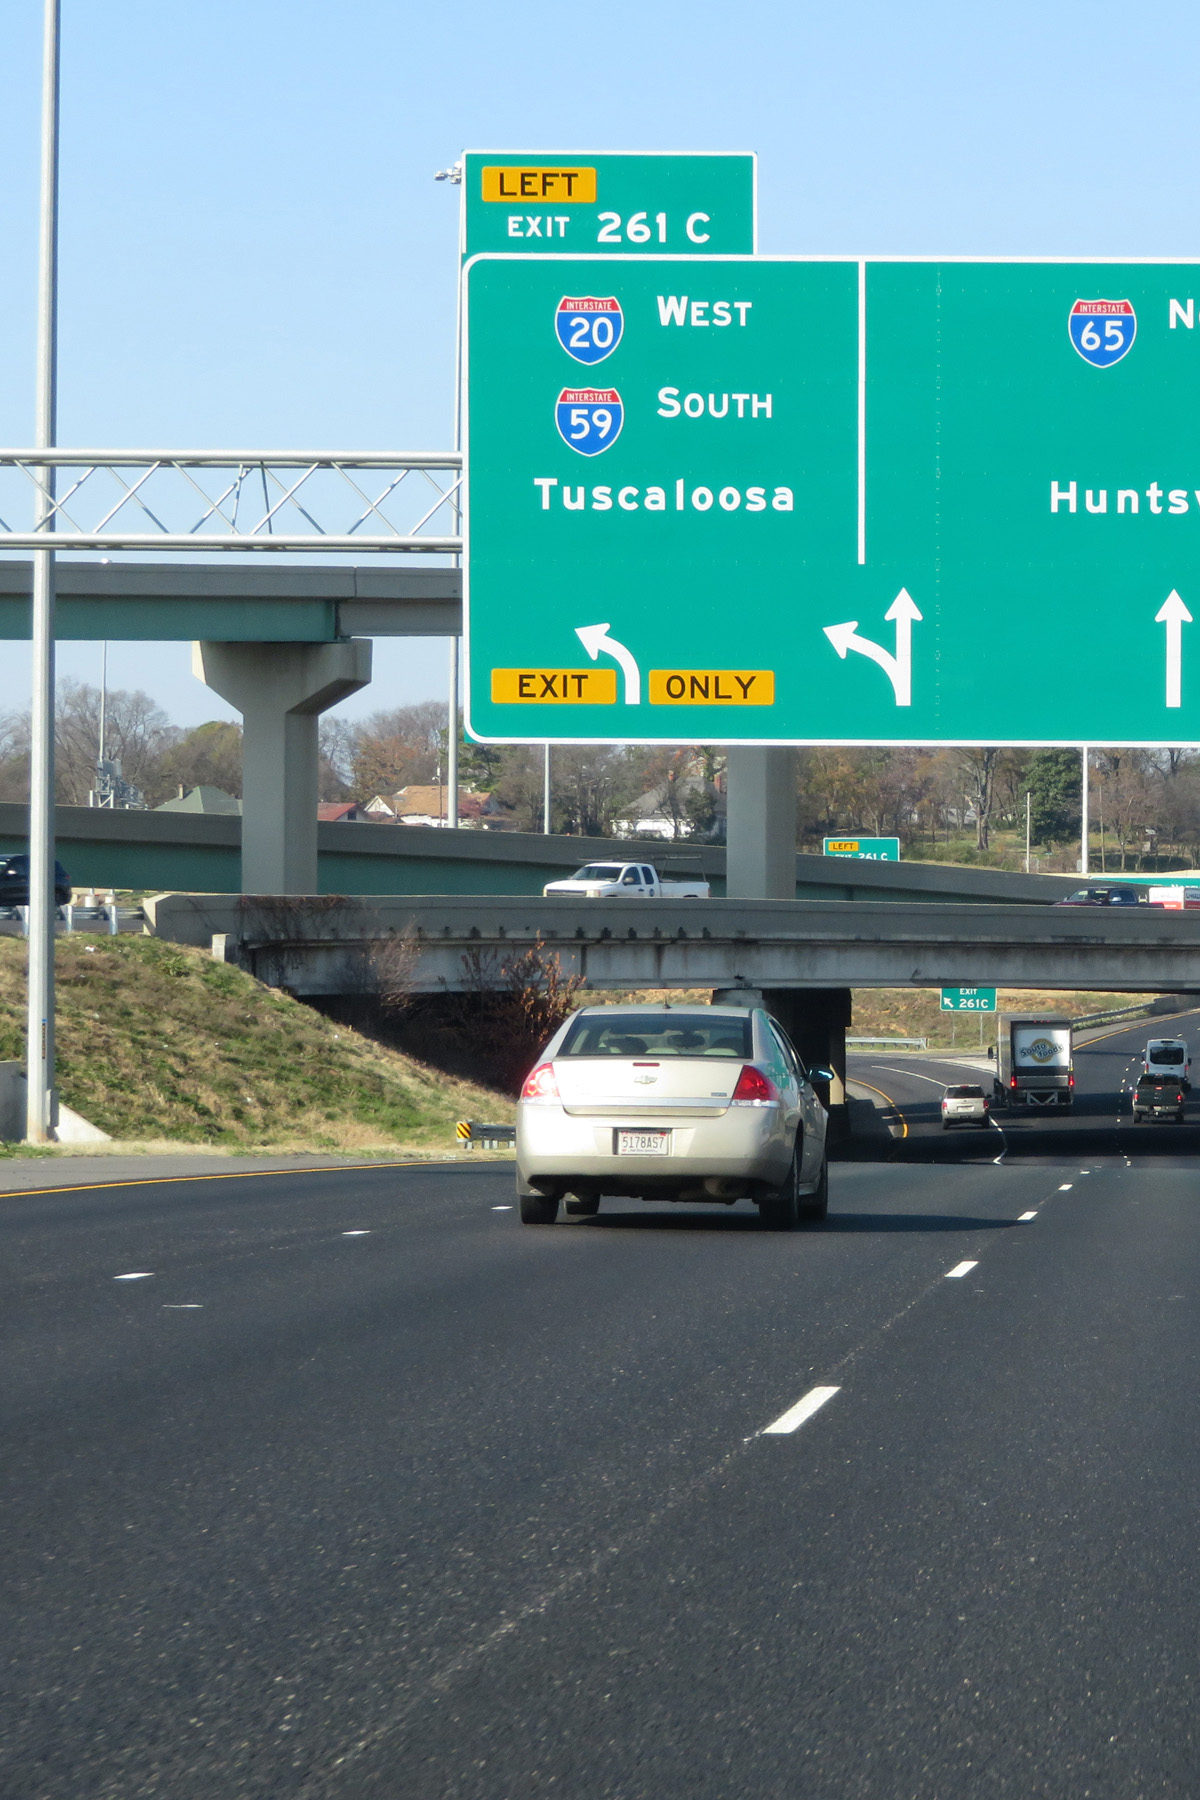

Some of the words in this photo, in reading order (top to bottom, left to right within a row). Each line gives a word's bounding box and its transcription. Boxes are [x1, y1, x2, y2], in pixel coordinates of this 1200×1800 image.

[499, 173, 579, 197] LEFT
[507, 215, 570, 238] EXIT
[597, 211, 667, 243] 261
[686, 212, 711, 244] C
[566, 301, 612, 310] INTERSTATE
[656, 295, 753, 327] WEST
[1080, 304, 1126, 313] INTERSTATE
[569, 316, 614, 348] 20
[1081, 320, 1125, 352] 65
[566, 393, 612, 402] INTERSTATE
[657, 386, 773, 419] SOUTH
[570, 408, 612, 440] 59
[533, 477, 794, 512] Tuscaloosa
[518, 674, 589, 698] EXIT
[666, 675, 756, 699] ONLY
[832, 842, 854, 850] LEFT
[858, 852, 877, 860] 261
[880, 852, 888, 861] C
[959, 987, 978, 995] EXIT
[959, 998, 989, 1009] 261C
[1020, 1043, 1046, 1057] Souto
[1039, 1045, 1063, 1058] foods
[622, 1136, 665, 1149] 5178AS7
